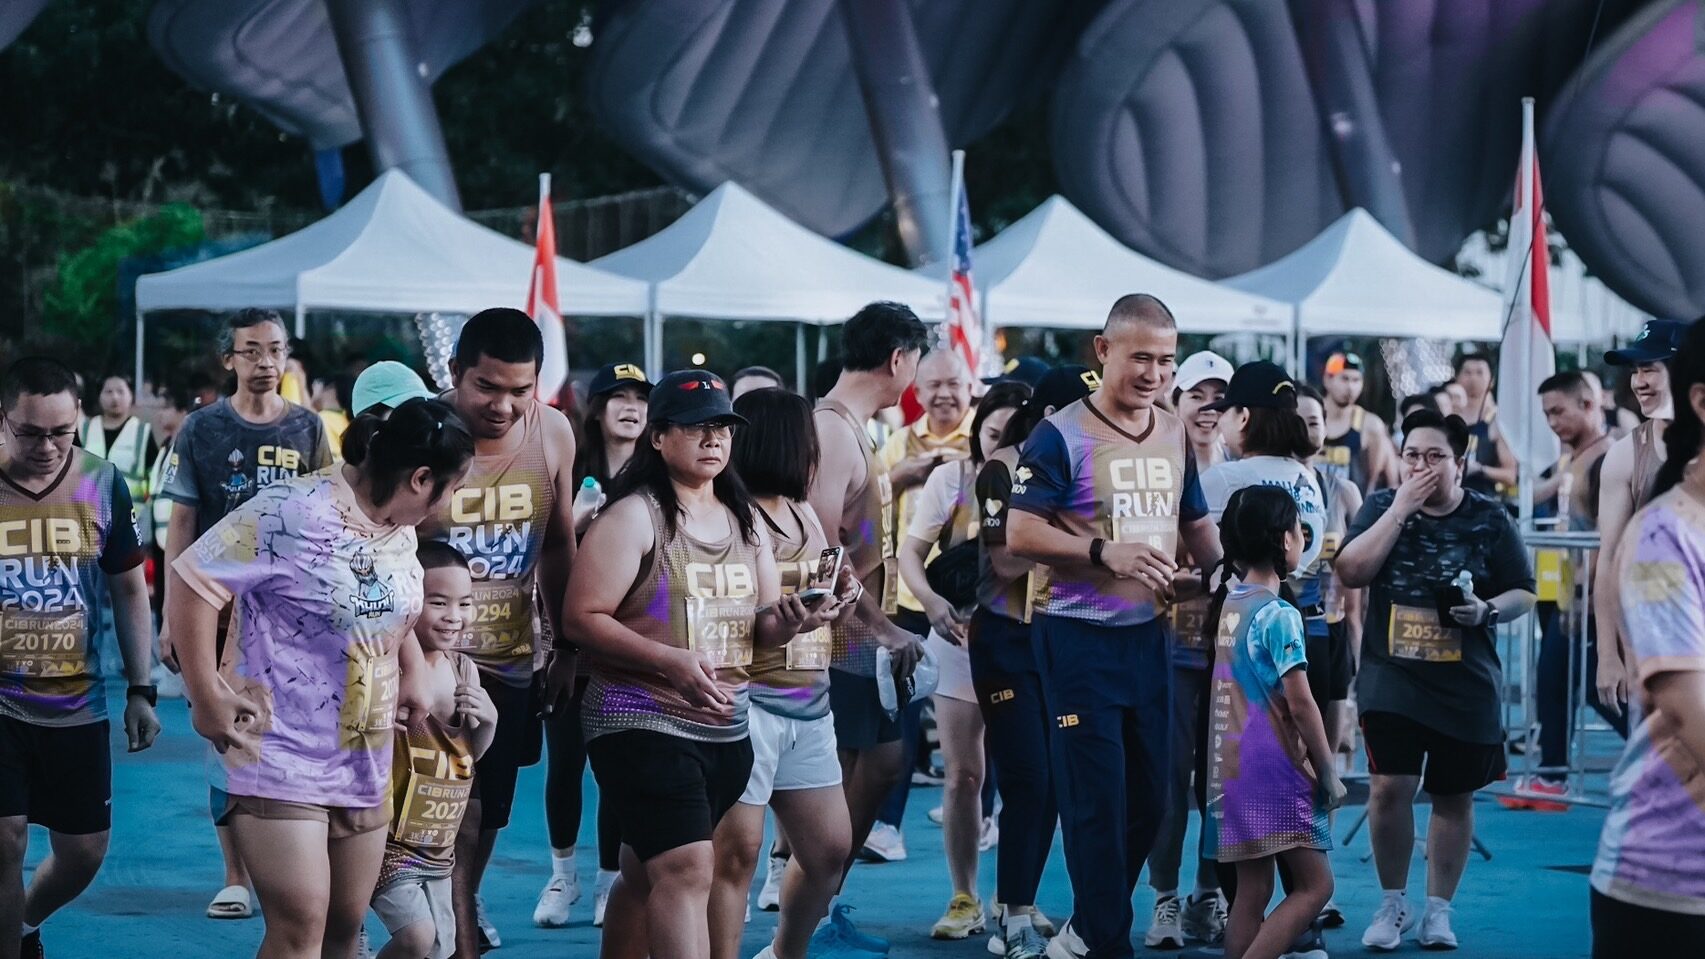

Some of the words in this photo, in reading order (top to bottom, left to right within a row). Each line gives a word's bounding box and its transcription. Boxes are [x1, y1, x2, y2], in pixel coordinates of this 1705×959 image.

[257, 445, 300, 469] CIB
[1110, 457, 1173, 490] CIB
[451, 484, 533, 523] CIB
[1112, 491, 1174, 518] RUN
[0, 518, 81, 556] CIB
[449, 521, 531, 554] RUN
[0, 556, 79, 588] RUN
[686, 562, 755, 598] CIB
[1, 587, 86, 612] 2024
[13, 632, 75, 651] 20170
[990, 689, 1015, 704] CIB
[409, 746, 474, 780] CIB
